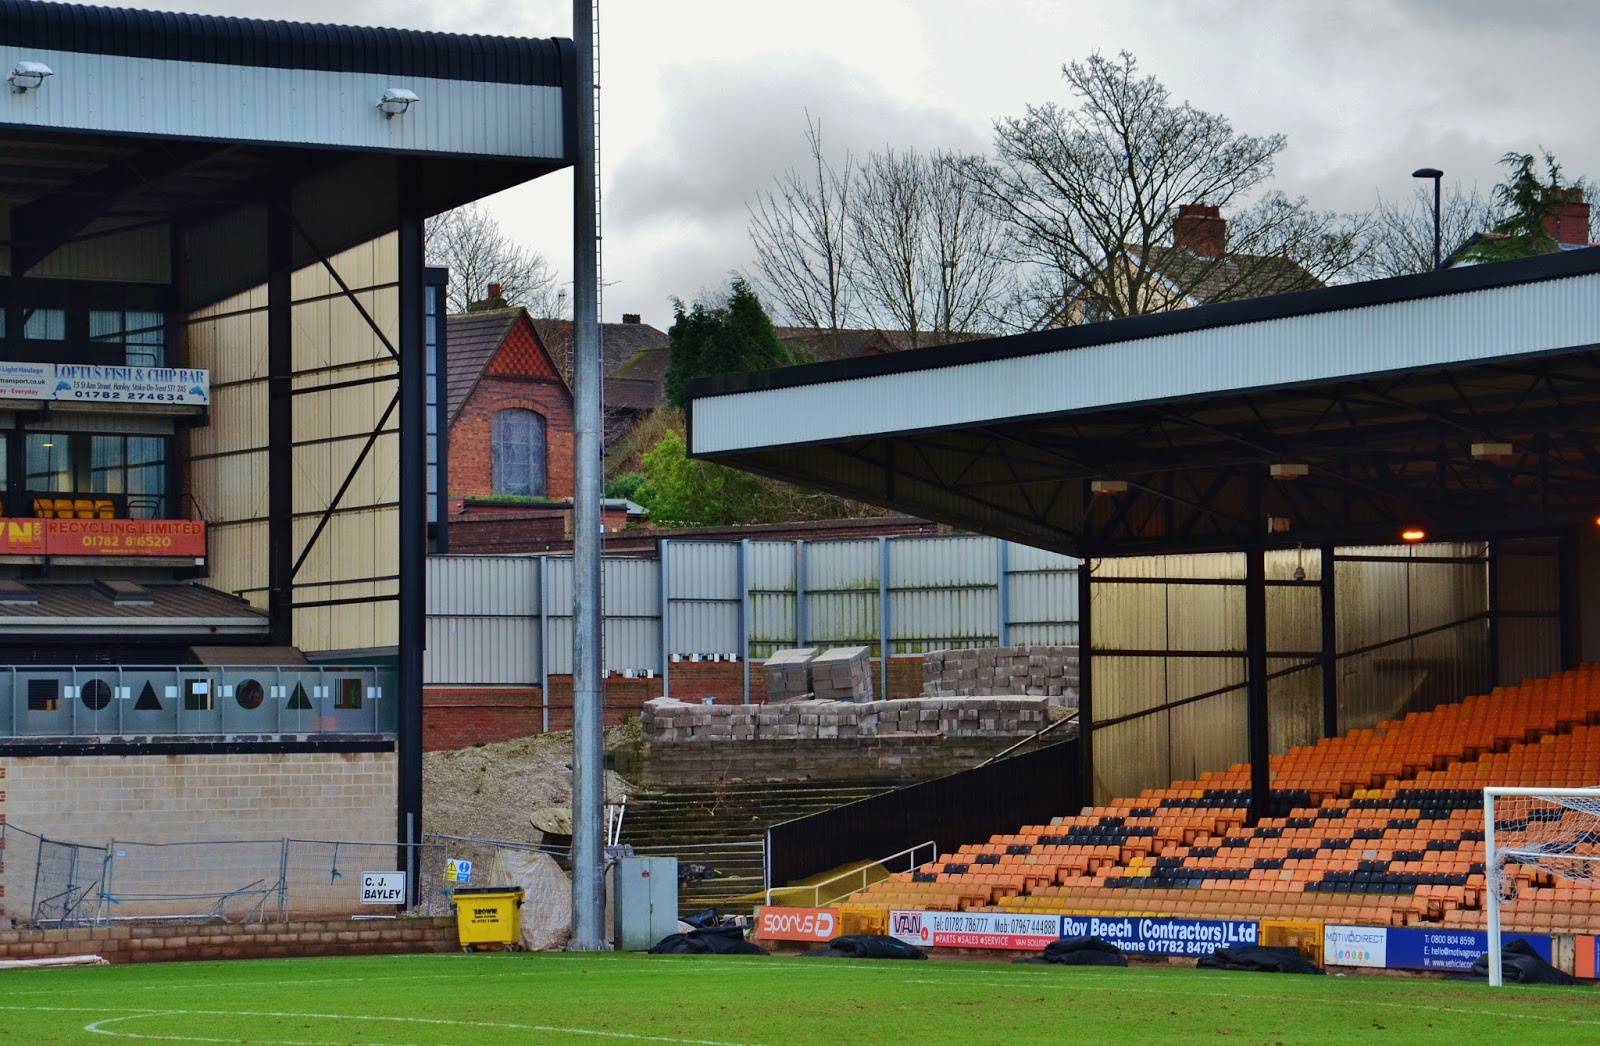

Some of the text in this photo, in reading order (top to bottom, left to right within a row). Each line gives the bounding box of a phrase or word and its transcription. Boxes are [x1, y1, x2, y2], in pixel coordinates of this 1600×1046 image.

[54, 366, 204, 383] LOFTUS FISH & CHIP BAR
[132, 384, 166, 392] Stoke-On-Trent
[49, 522, 200, 534] RECYCLING LIMITED
[82, 536, 171, 547] 01782 816520
[365, 877, 386, 886] C. J.
[364, 890, 401, 899] BAYLEY
[893, 913, 922, 936] VAN
[934, 916, 1056, 934] Tel: 01782 786777 Mob: 07967 444888
[1064, 918, 1256, 943] Roy Beech (Contractors) Ltd
[940, 934, 1055, 947] PARTS SALES SERVICE VAN SOLUTION
[1425, 935, 1475, 945] T: 0800 804 8598
[1148, 940, 1184, 953] 01782
[1424, 946, 1430, 954] E:
[1424, 958, 1476, 968] W: www.vehiclecon
